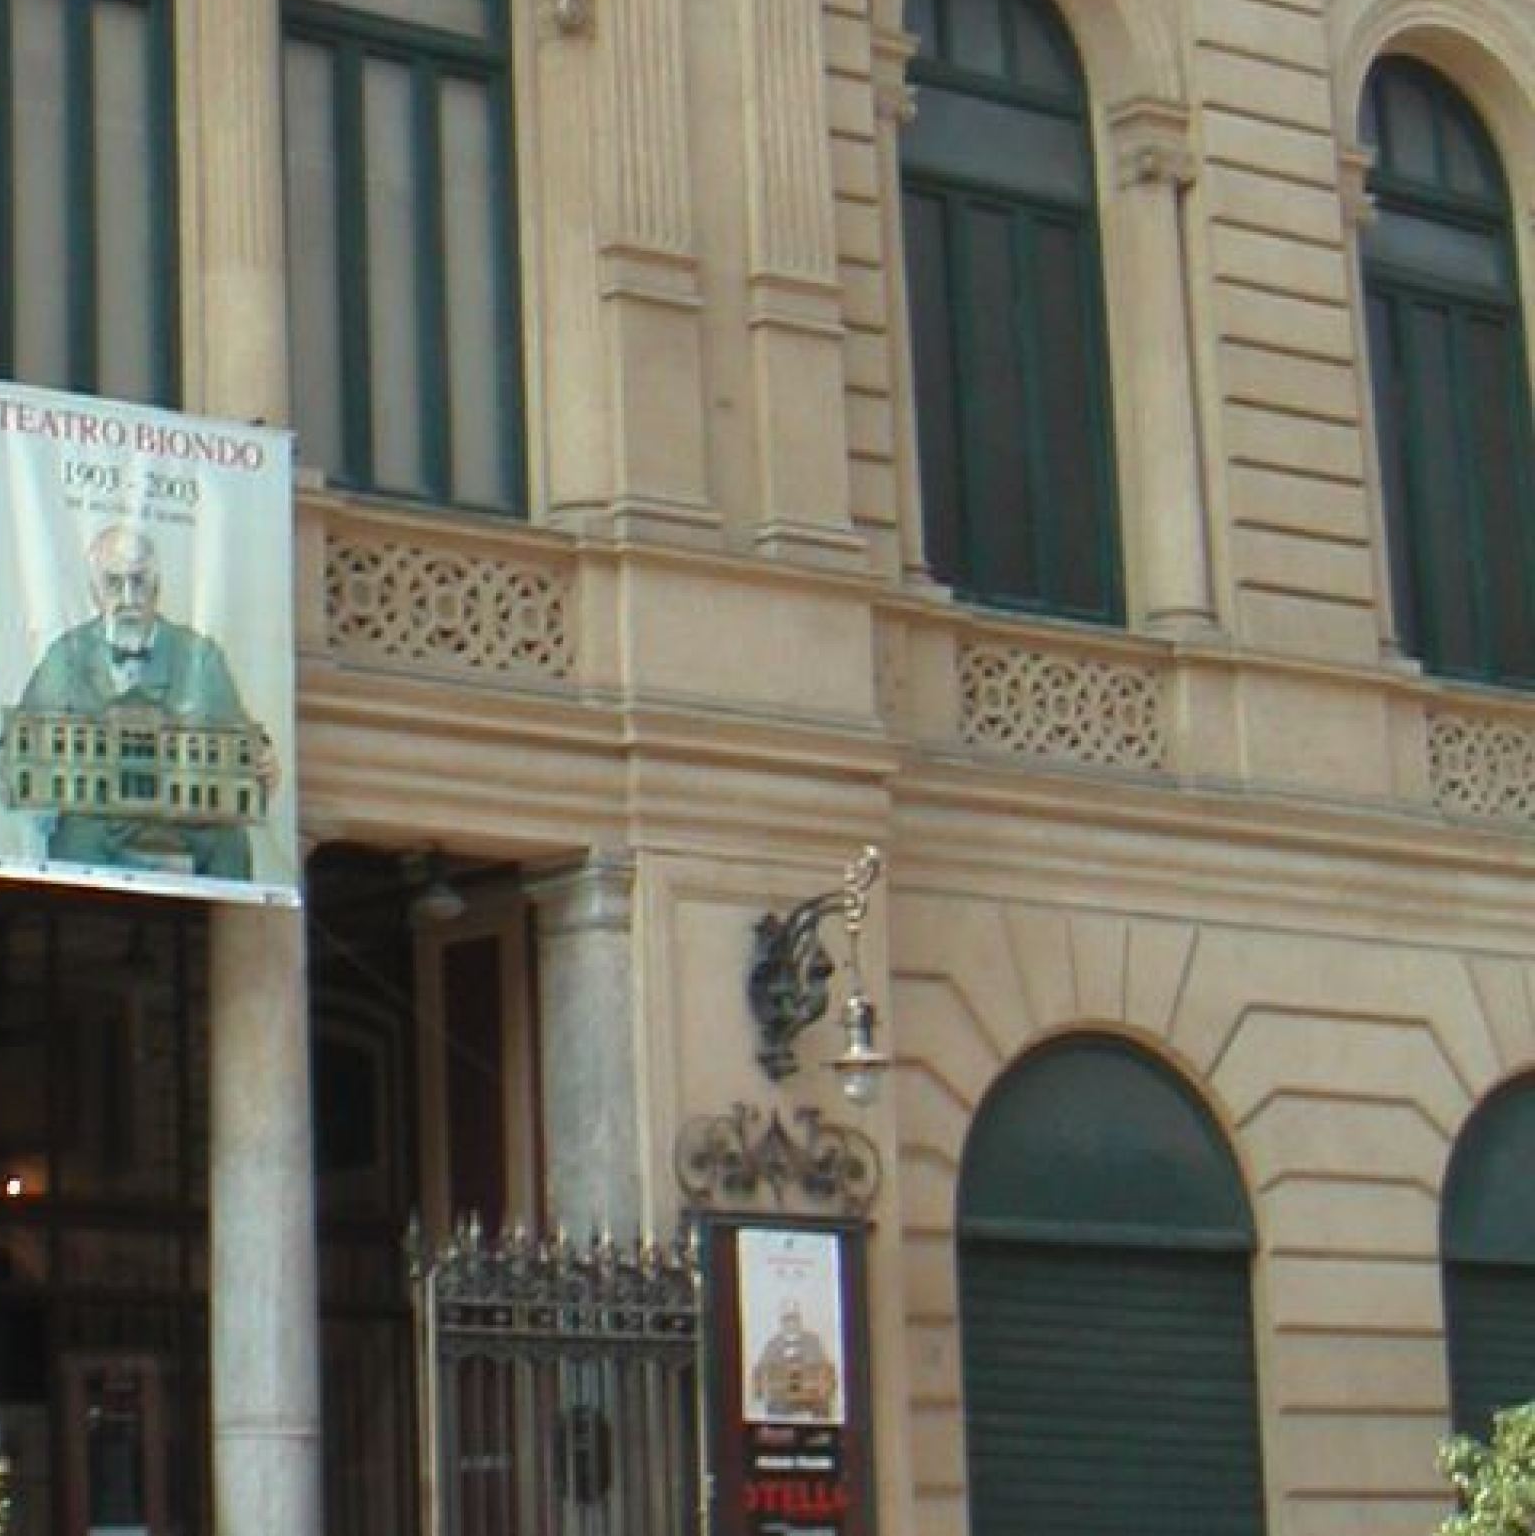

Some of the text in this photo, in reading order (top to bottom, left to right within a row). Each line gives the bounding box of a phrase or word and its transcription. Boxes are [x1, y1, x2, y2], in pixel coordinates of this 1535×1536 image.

[135, 422, 264, 470] BIONDO
[65, 461, 121, 495] 1903
[145, 470, 200, 508] 2003
